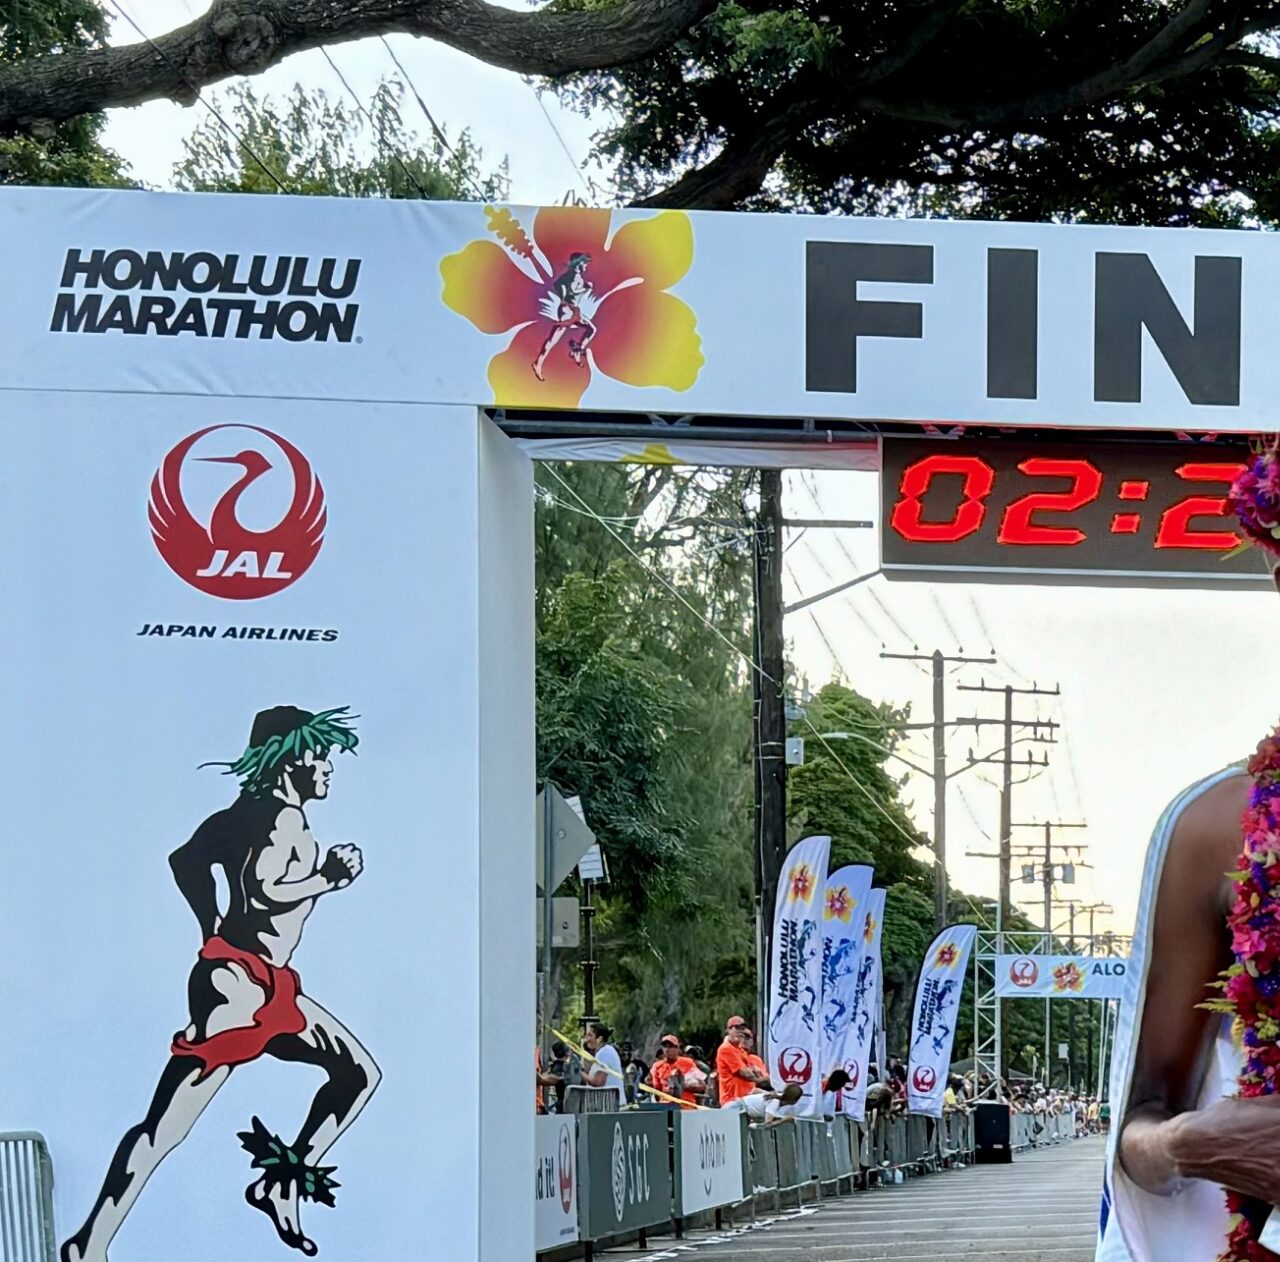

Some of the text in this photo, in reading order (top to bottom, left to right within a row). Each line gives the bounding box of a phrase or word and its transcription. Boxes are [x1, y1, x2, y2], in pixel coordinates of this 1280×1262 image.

[60, 249, 362, 299] HONOLULU
[50, 294, 359, 343] MARATHON
[196, 549, 292, 580] JAL
[136, 623, 338, 642] JAPAN AIRLINES
[777, 918, 790, 999] HONOLULU
[1091, 962, 1126, 976] ALO
